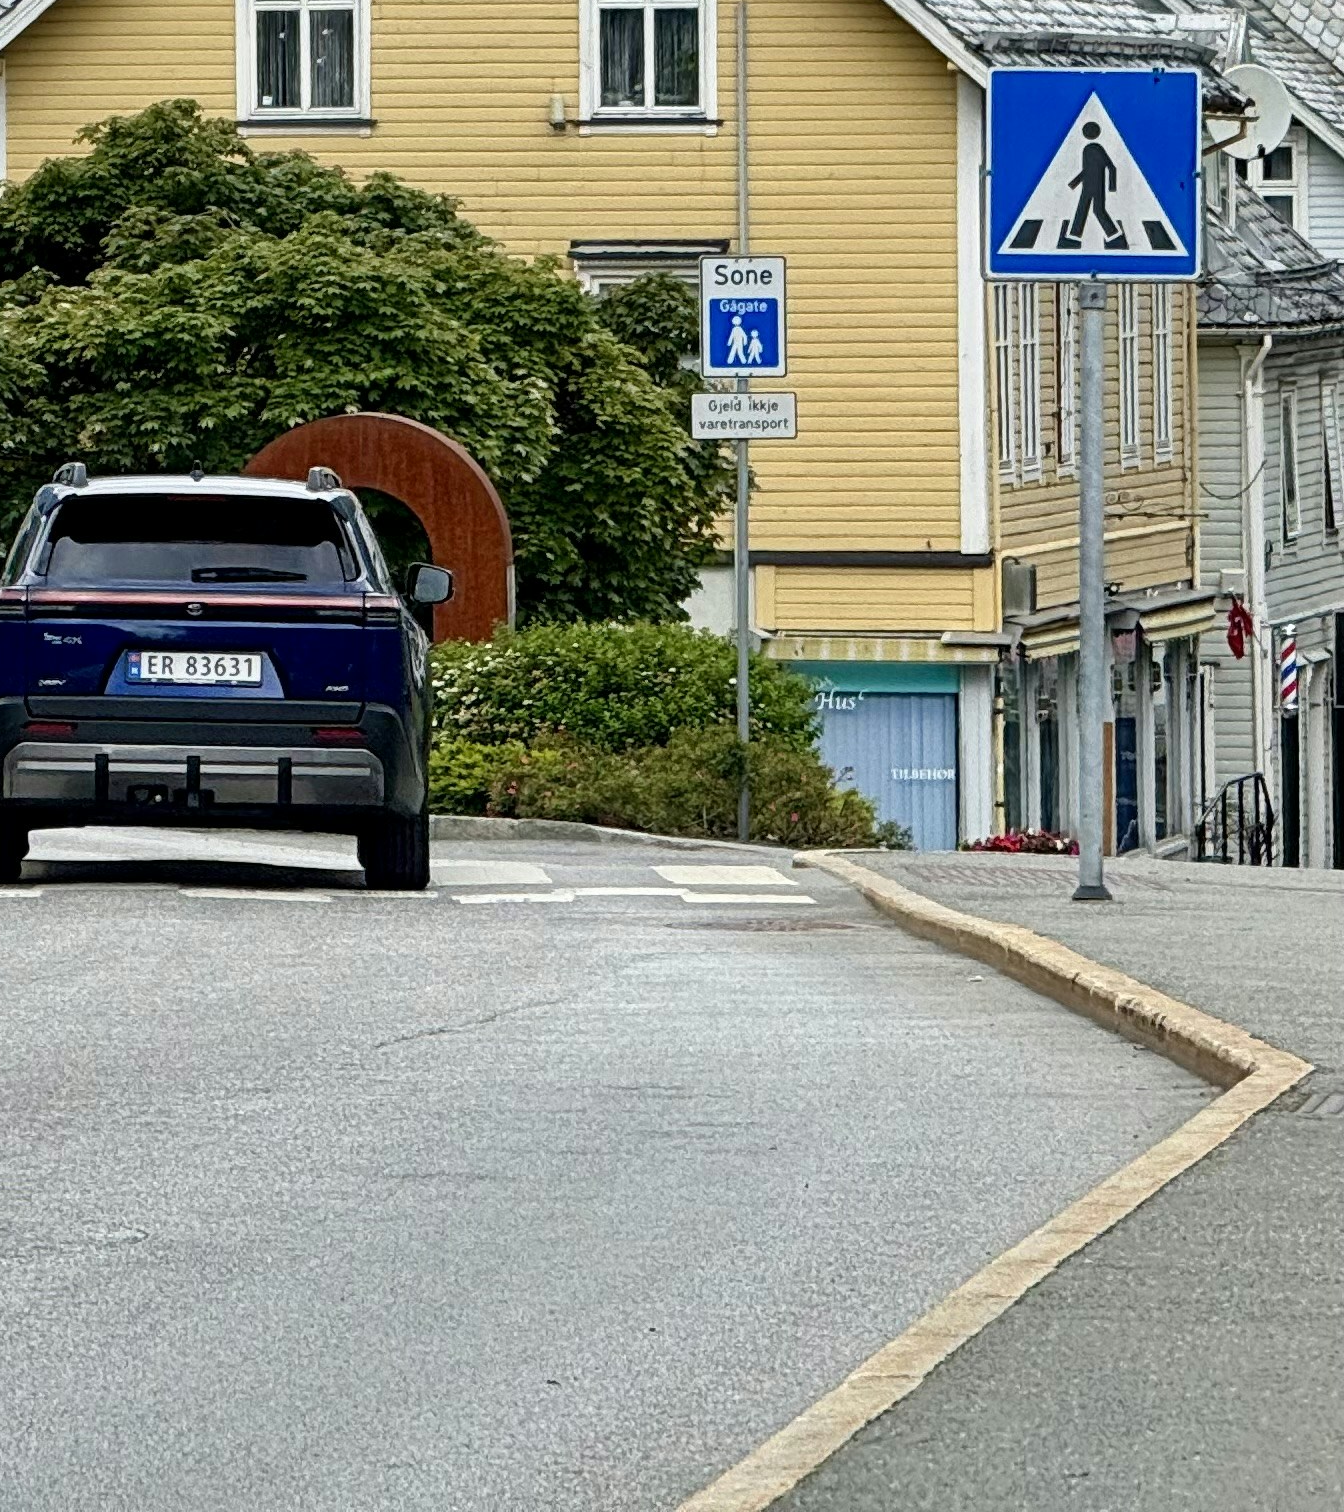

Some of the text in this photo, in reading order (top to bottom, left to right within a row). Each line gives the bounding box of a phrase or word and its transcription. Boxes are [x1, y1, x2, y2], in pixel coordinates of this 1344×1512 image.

[714, 264, 773, 286] Sone
[719, 299, 768, 315] Gågate
[698, 418, 789, 432] varetransport
[147, 655, 253, 678] ER 83631
